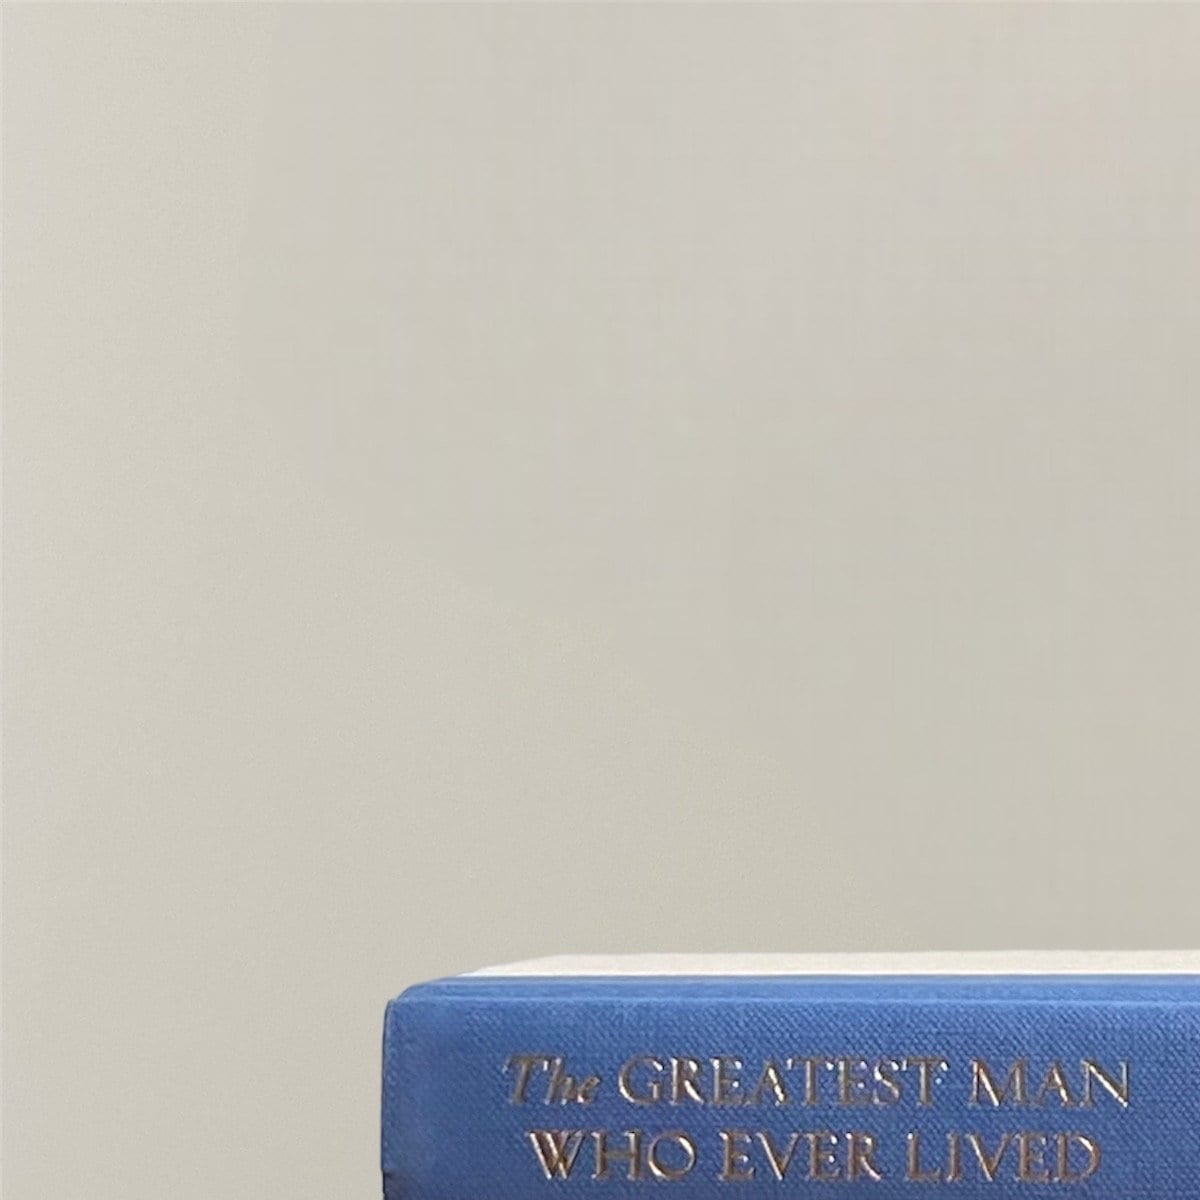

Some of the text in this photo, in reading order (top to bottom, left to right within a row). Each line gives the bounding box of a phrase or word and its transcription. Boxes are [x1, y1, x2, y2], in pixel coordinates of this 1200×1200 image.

[503, 1054, 1132, 1109] The GREATEST MAN
[526, 1129, 1102, 1183] WHO EVER LIVED
